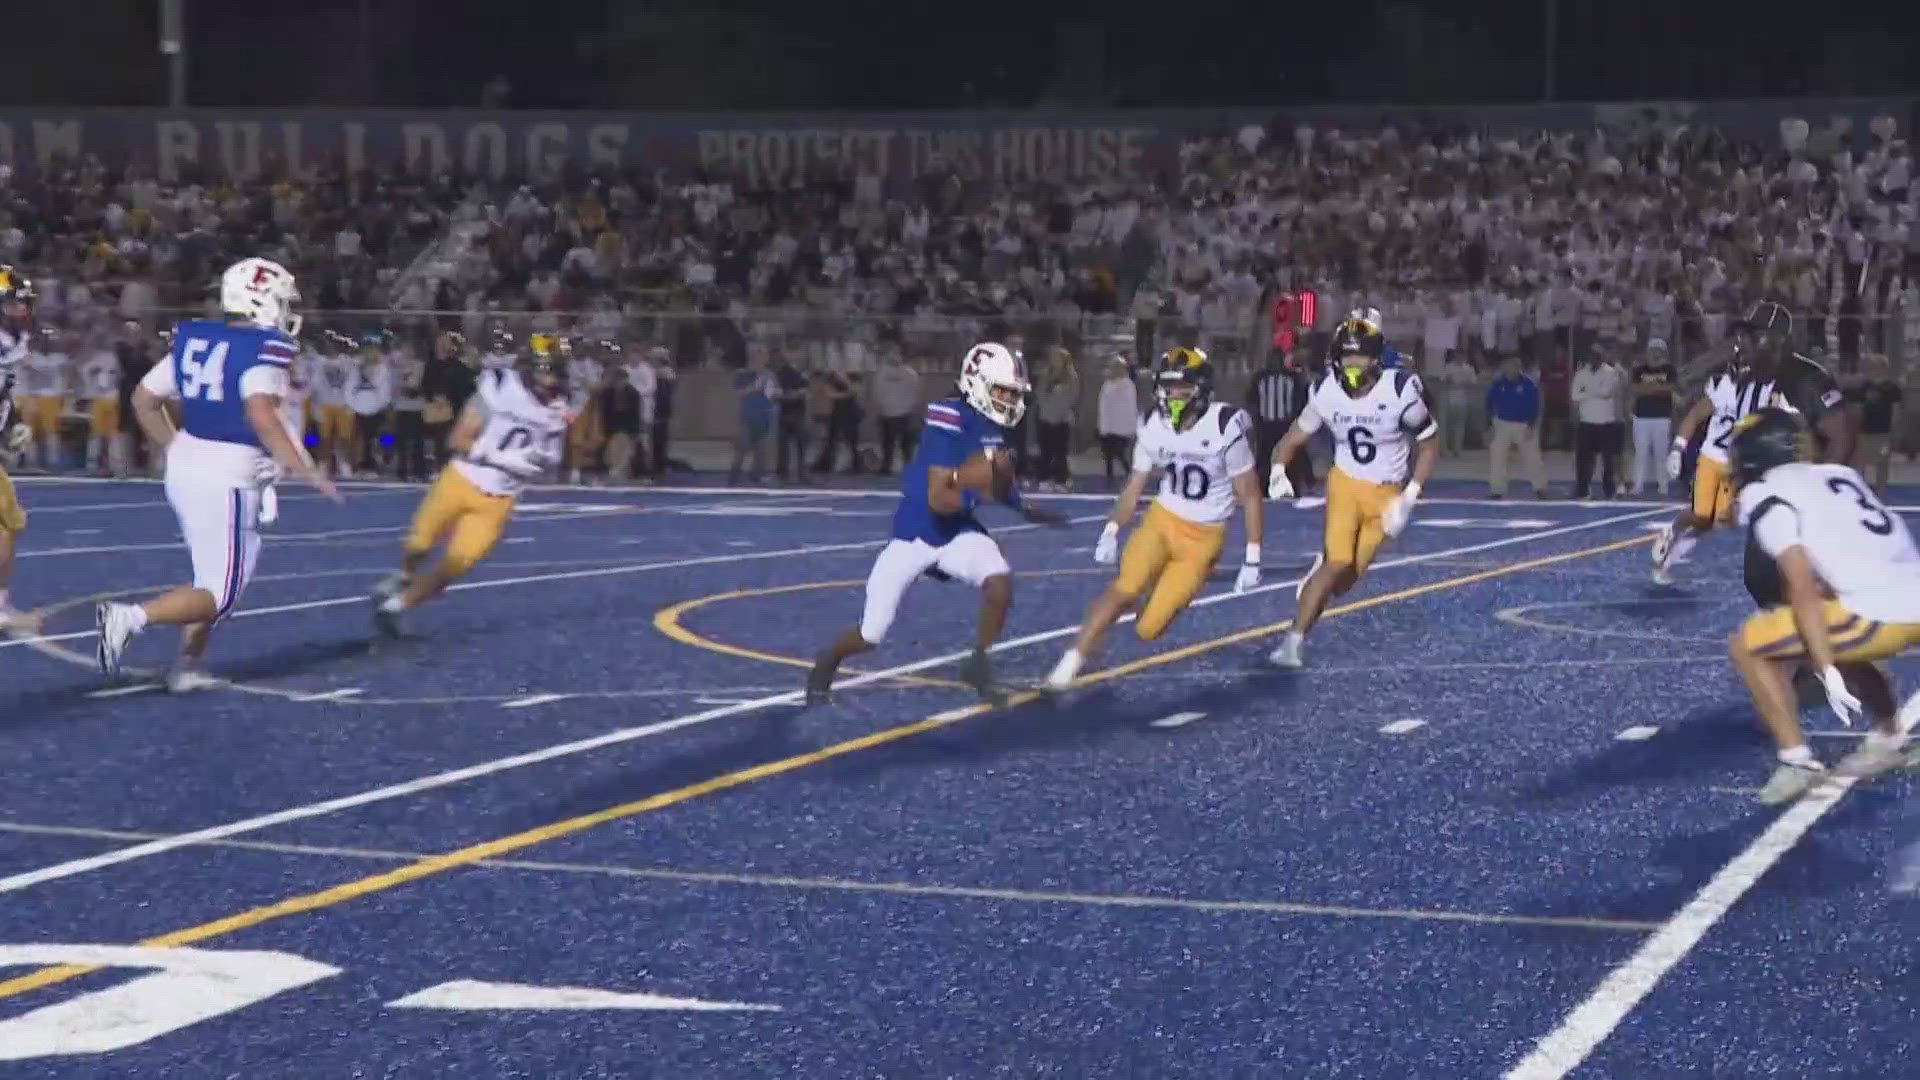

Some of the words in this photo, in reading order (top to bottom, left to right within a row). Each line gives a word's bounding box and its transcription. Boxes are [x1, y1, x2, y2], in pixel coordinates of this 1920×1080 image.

[698, 129, 896, 186] PROTECT
[994, 128, 1150, 179] HOUSE
[180, 337, 230, 402] 54
[1347, 426, 1376, 464] 6
[1164, 462, 1209, 501] 10
[1825, 476, 1892, 536] 3
